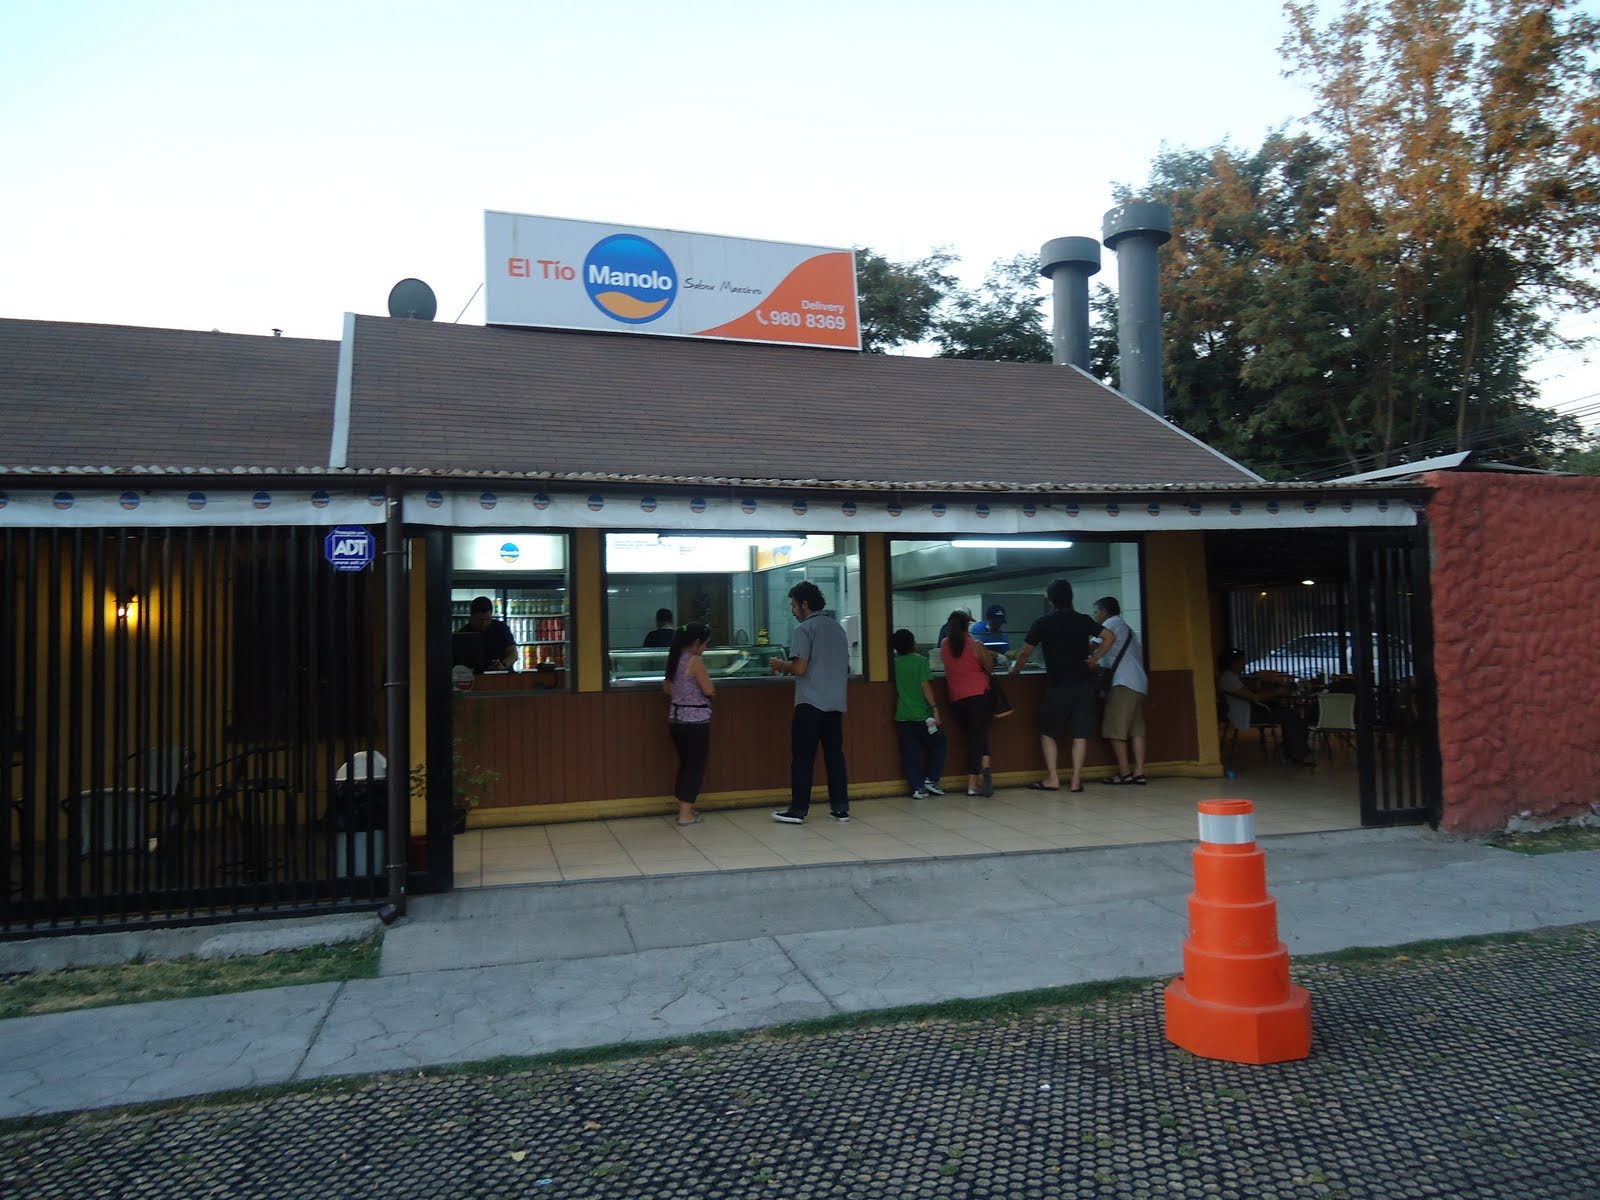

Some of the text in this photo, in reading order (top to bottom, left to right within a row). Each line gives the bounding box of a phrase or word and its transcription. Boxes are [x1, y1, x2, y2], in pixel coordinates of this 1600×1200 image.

[508, 257, 576, 281] El Tío
[588, 263, 673, 291] Manolo
[801, 299, 845, 314] Delivery
[770, 310, 846, 330] 980 8369
[333, 539, 368, 556] ADT
